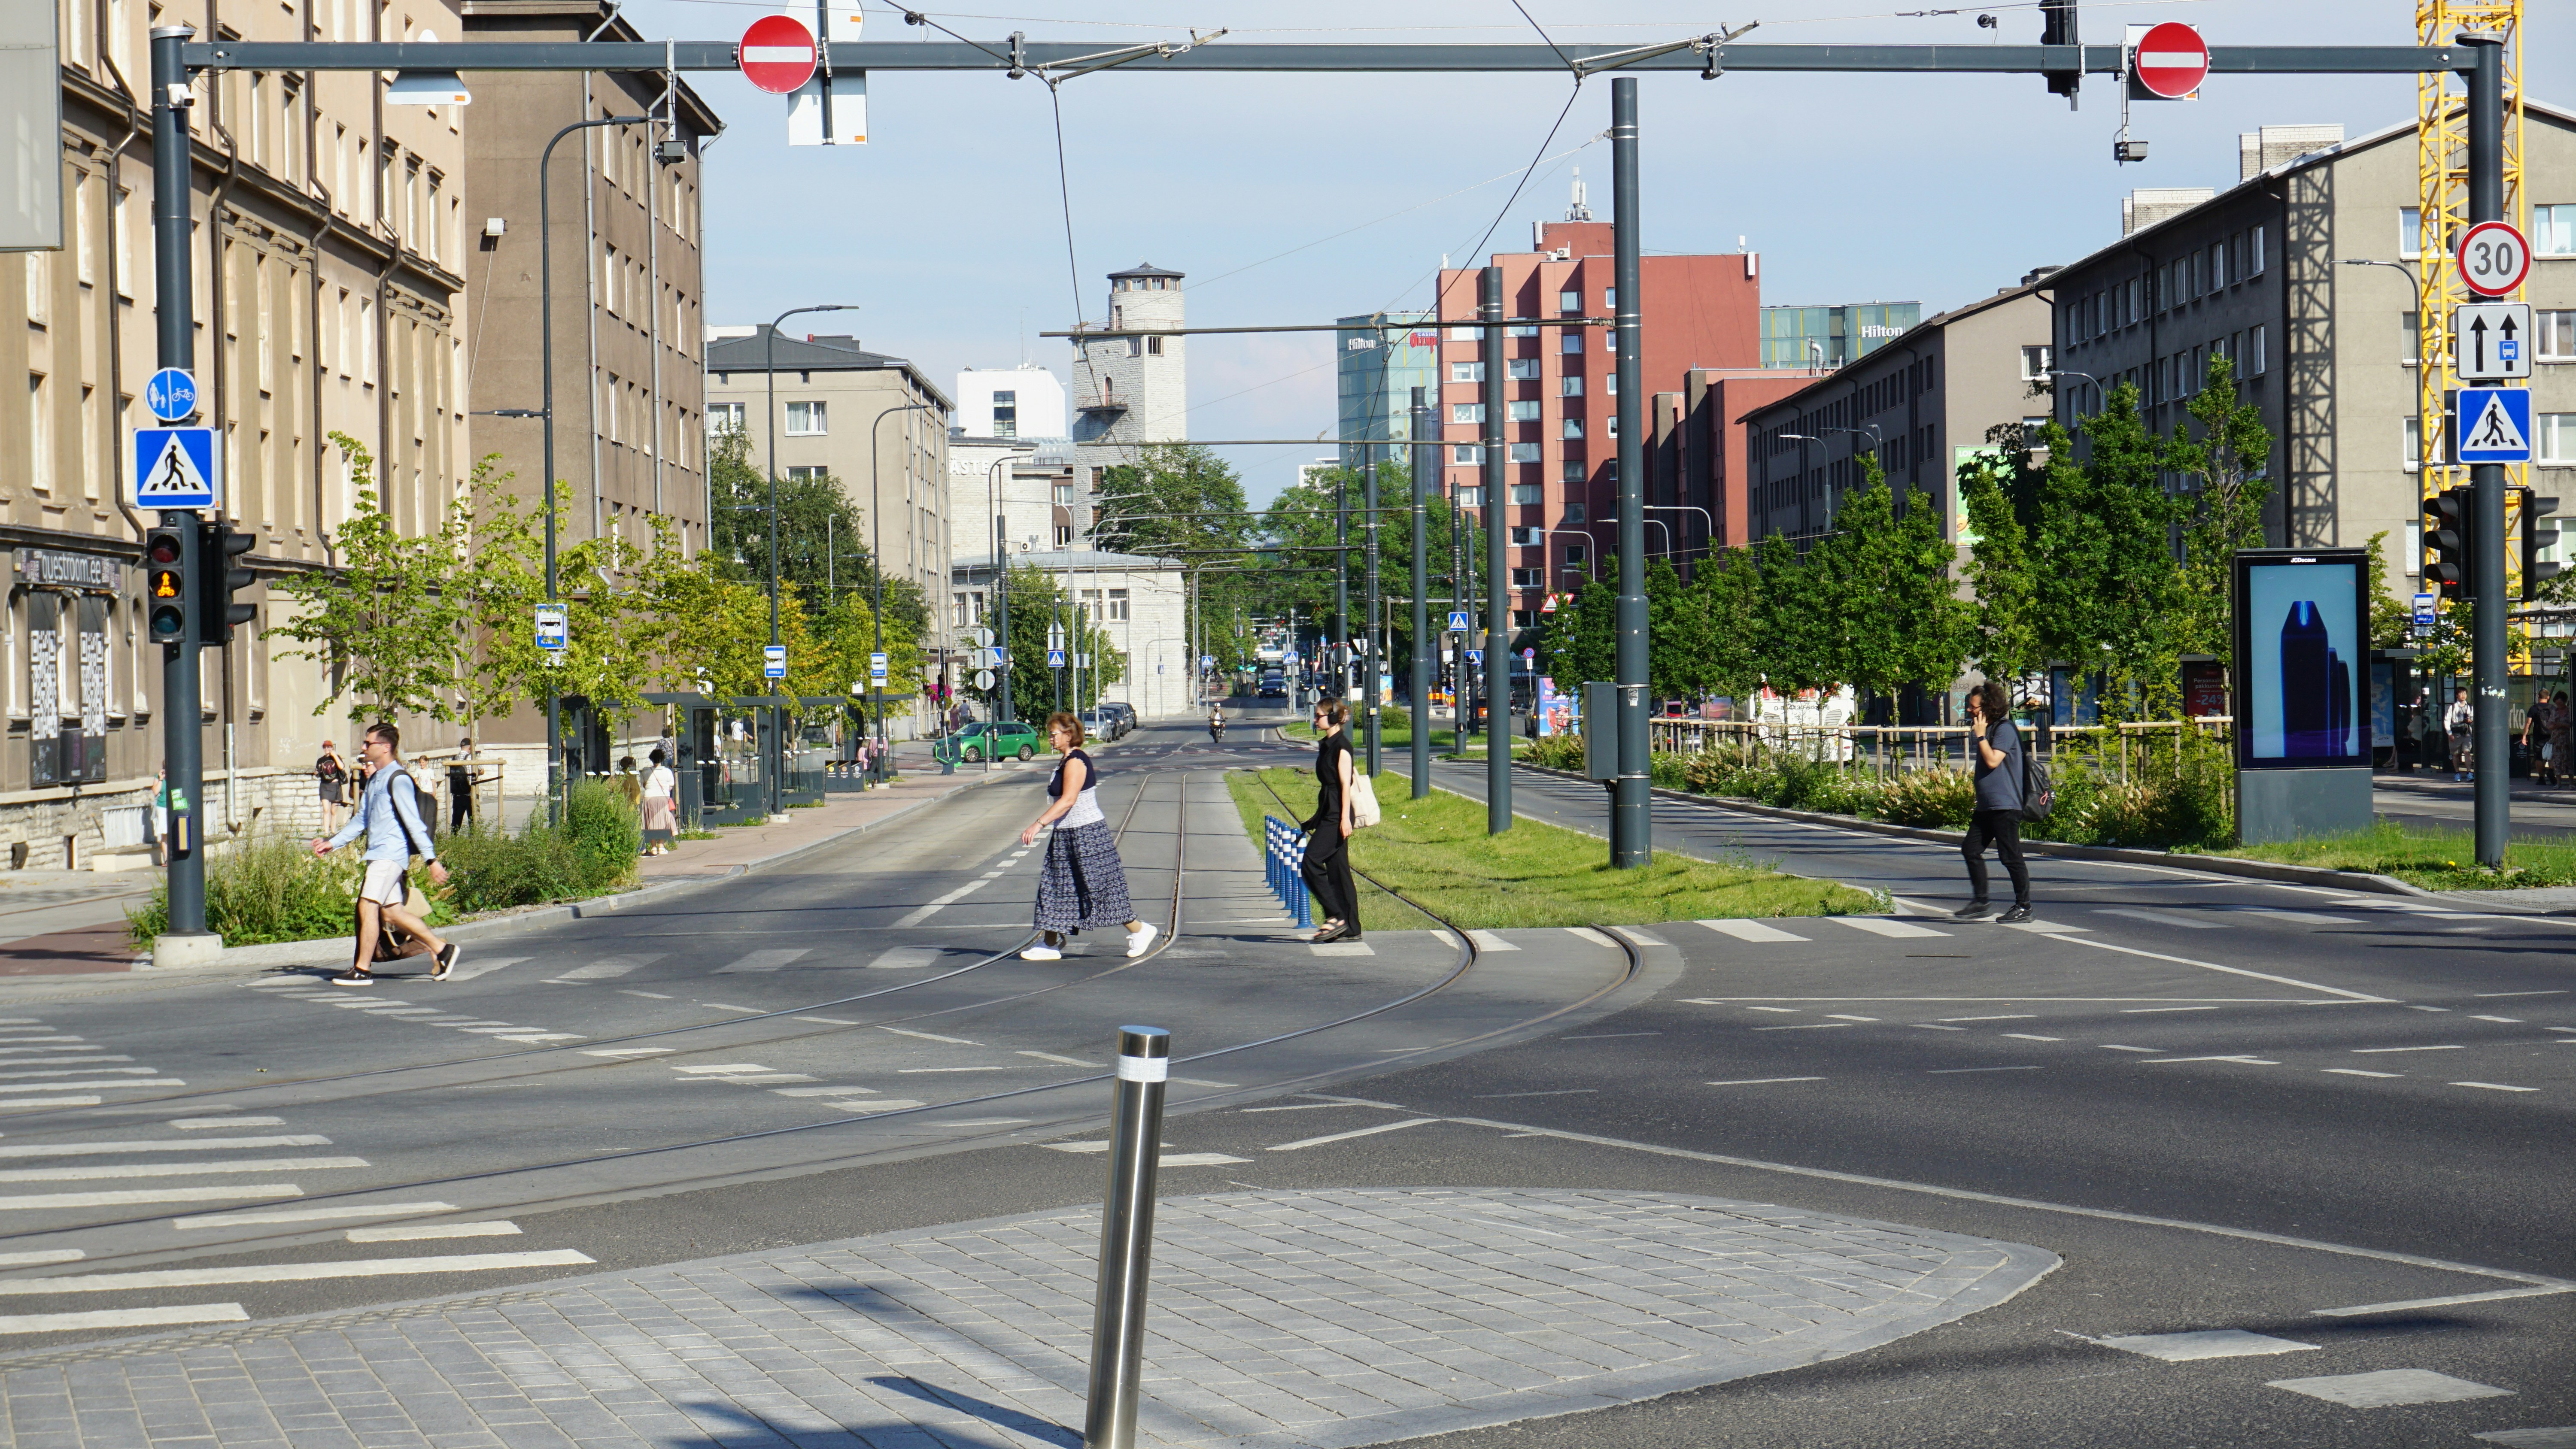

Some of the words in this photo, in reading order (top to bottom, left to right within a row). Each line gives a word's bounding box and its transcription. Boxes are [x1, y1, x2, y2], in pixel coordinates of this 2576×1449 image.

[2474, 242, 2512, 276] 30
[1862, 325, 1903, 338] Hilton
[1349, 337, 1376, 351] Hilton
[949, 458, 989, 475] ÄSTE
[42, 553, 101, 584] questroom.ee
[2196, 694, 2224, 705] -24%
[2509, 703, 2525, 730] rko
